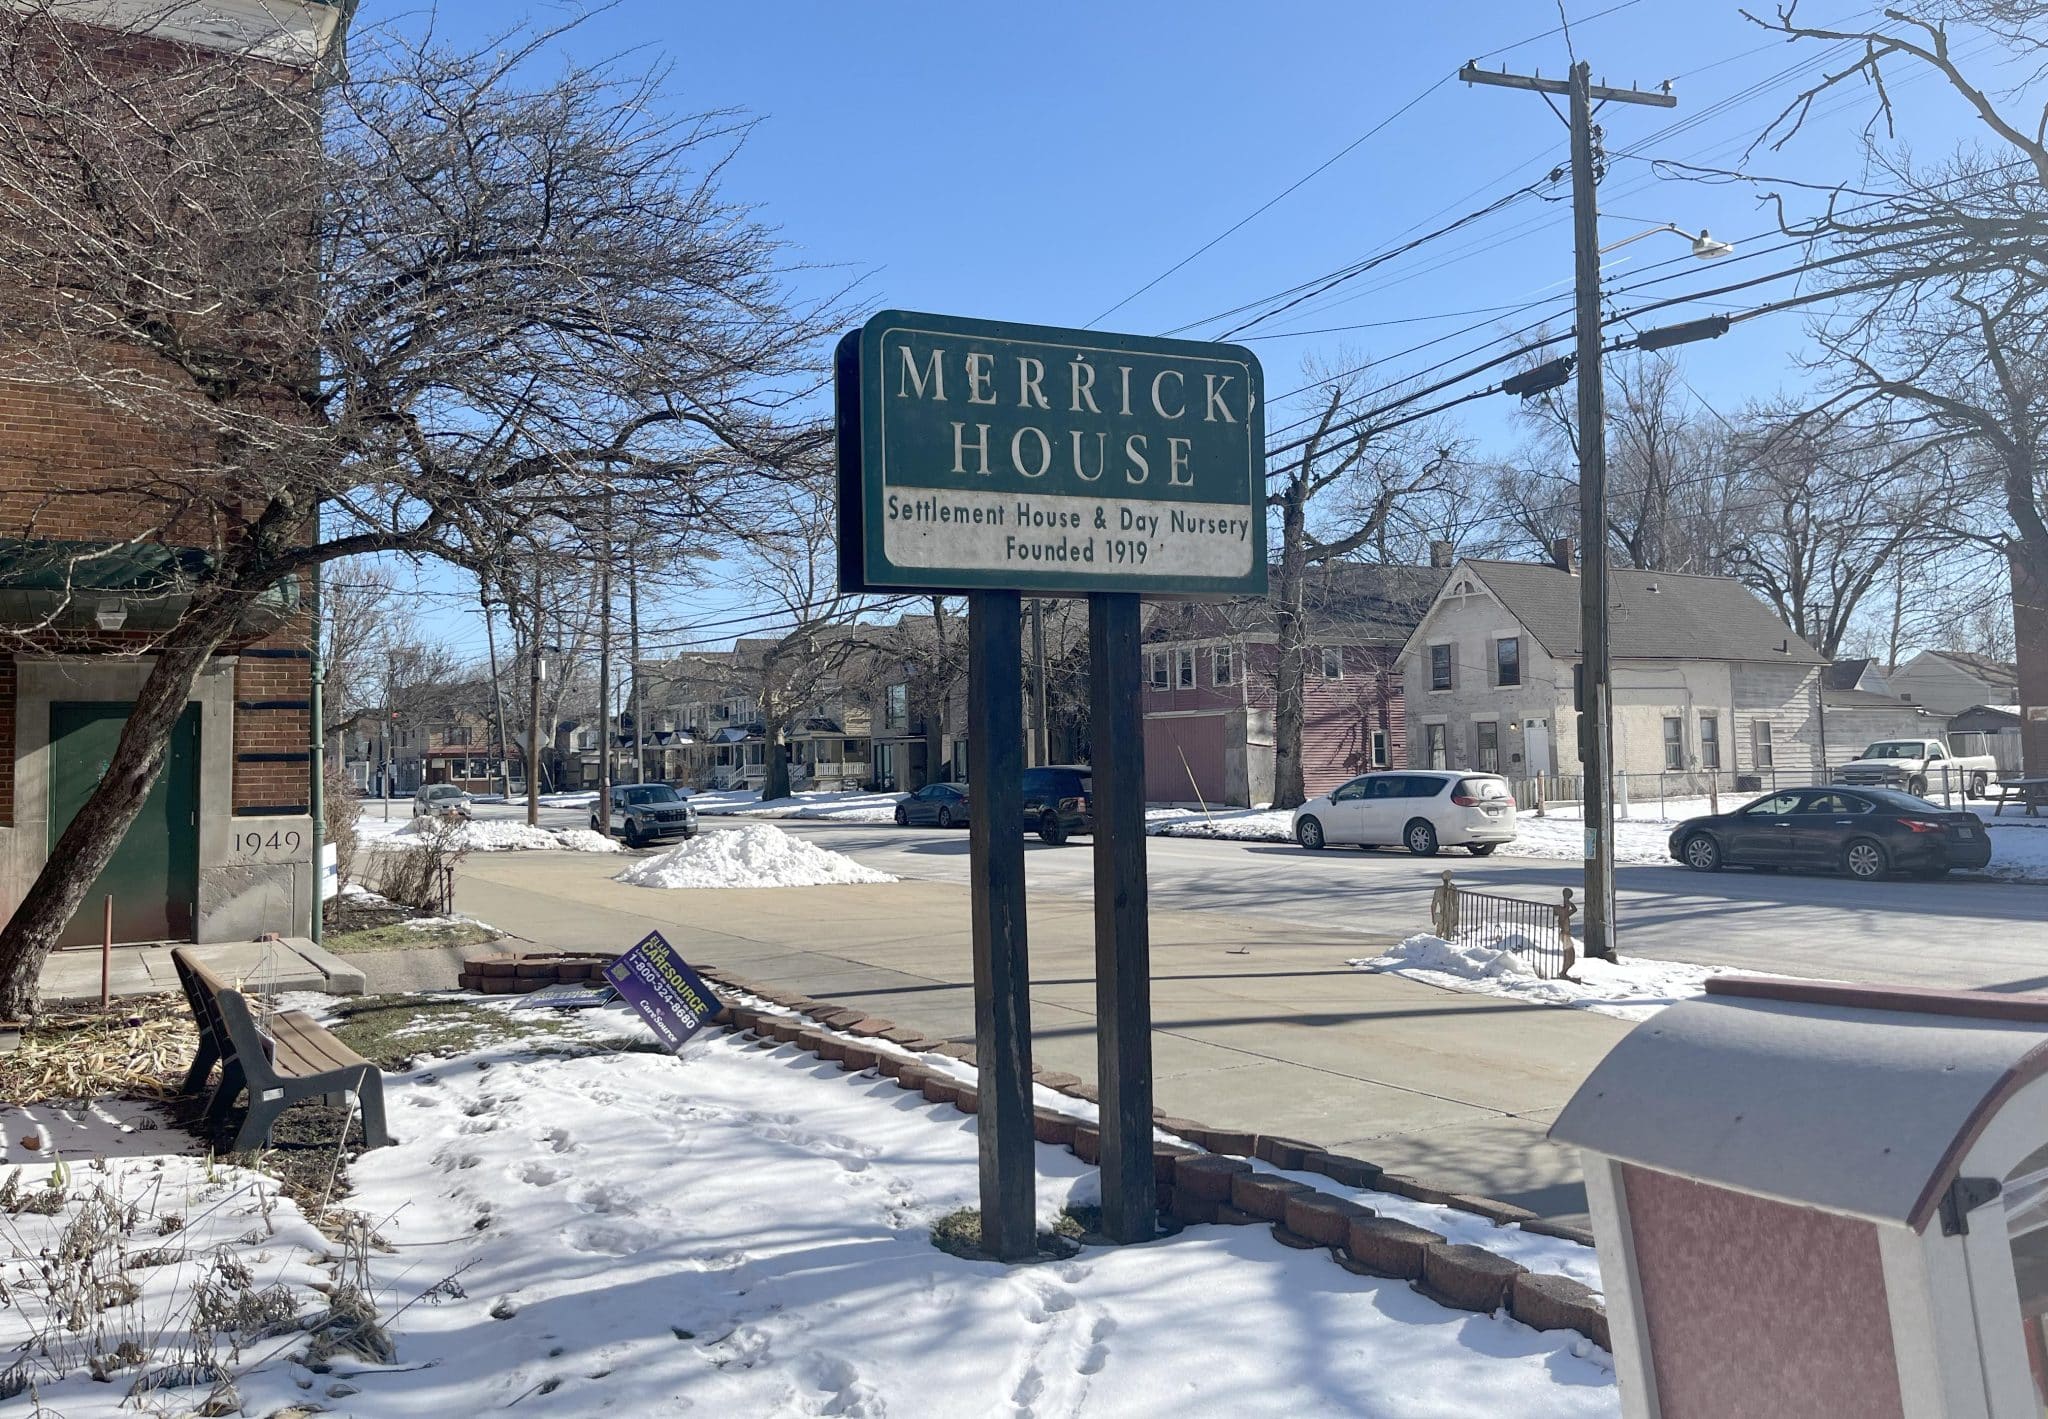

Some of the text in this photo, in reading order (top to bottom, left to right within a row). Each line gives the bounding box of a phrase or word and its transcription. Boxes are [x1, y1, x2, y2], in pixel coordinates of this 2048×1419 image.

[898, 345, 1237, 423] MERRICK
[951, 422, 1194, 487] HOUSE
[888, 494, 1249, 541] Settlement House & Day Nursery
[1006, 536, 1148, 564] Founded 1919
[236, 830, 300, 856] 1949
[629, 953, 695, 1029] 1-800-324-8680
[641, 941, 707, 1014] CARESOURCE
